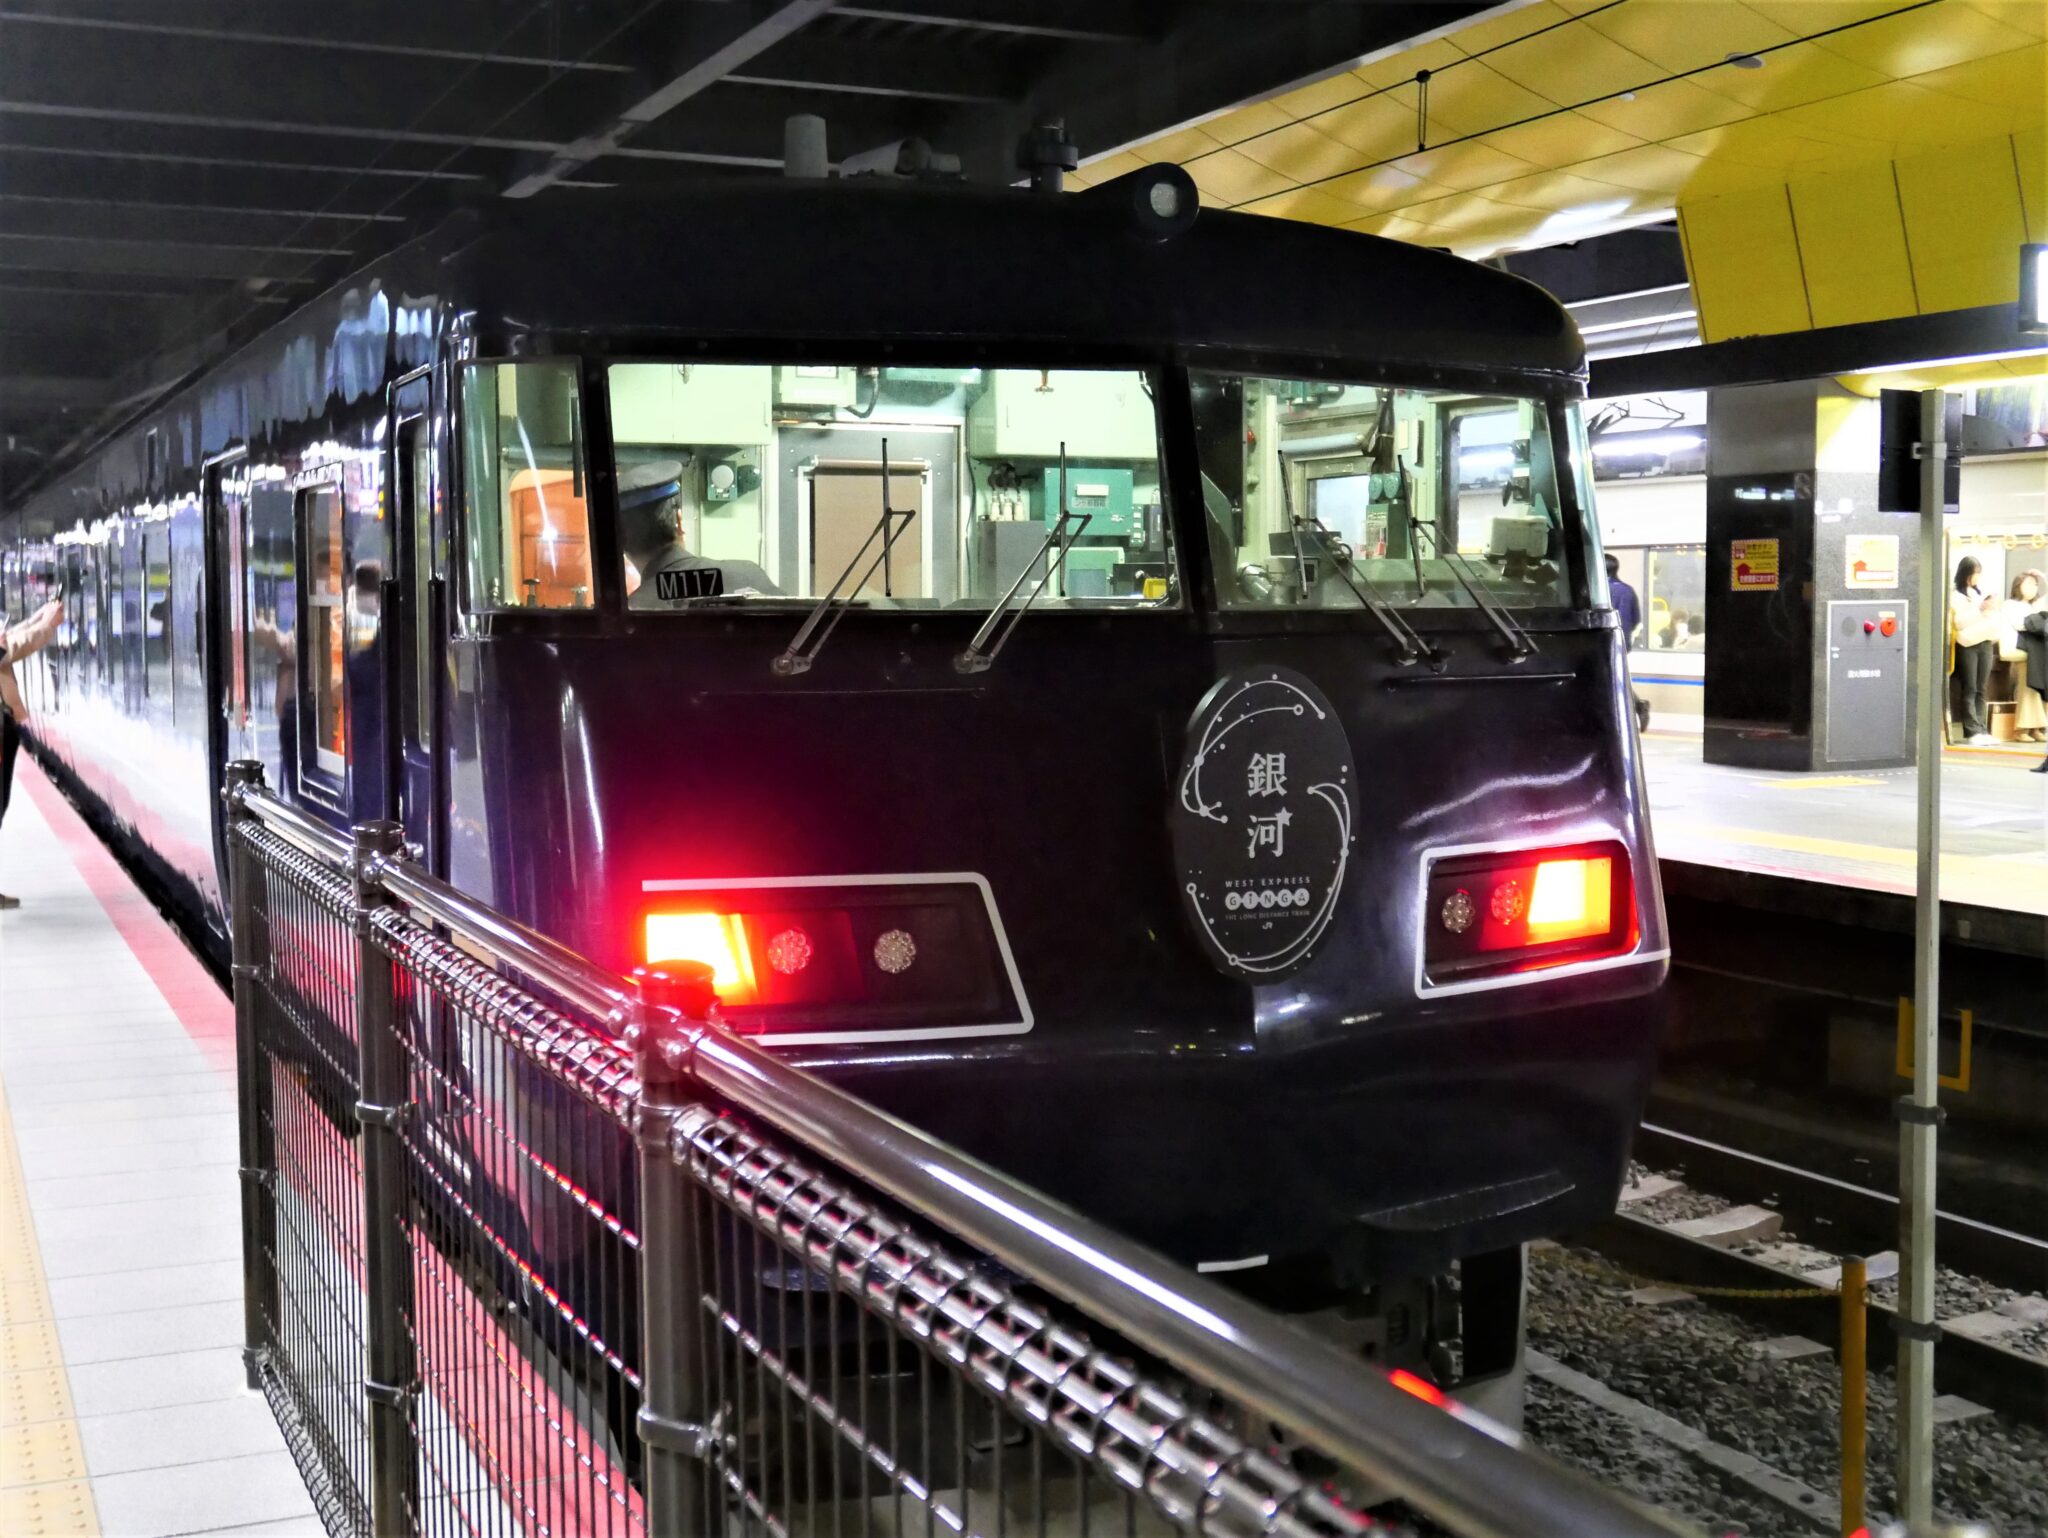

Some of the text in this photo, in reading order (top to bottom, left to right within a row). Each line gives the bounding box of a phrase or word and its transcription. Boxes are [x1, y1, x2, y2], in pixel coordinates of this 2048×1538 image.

[660, 570, 717, 598] M117
[1247, 752, 1293, 859] 銀河
[1225, 877, 1310, 888] WEST EXPRESS
